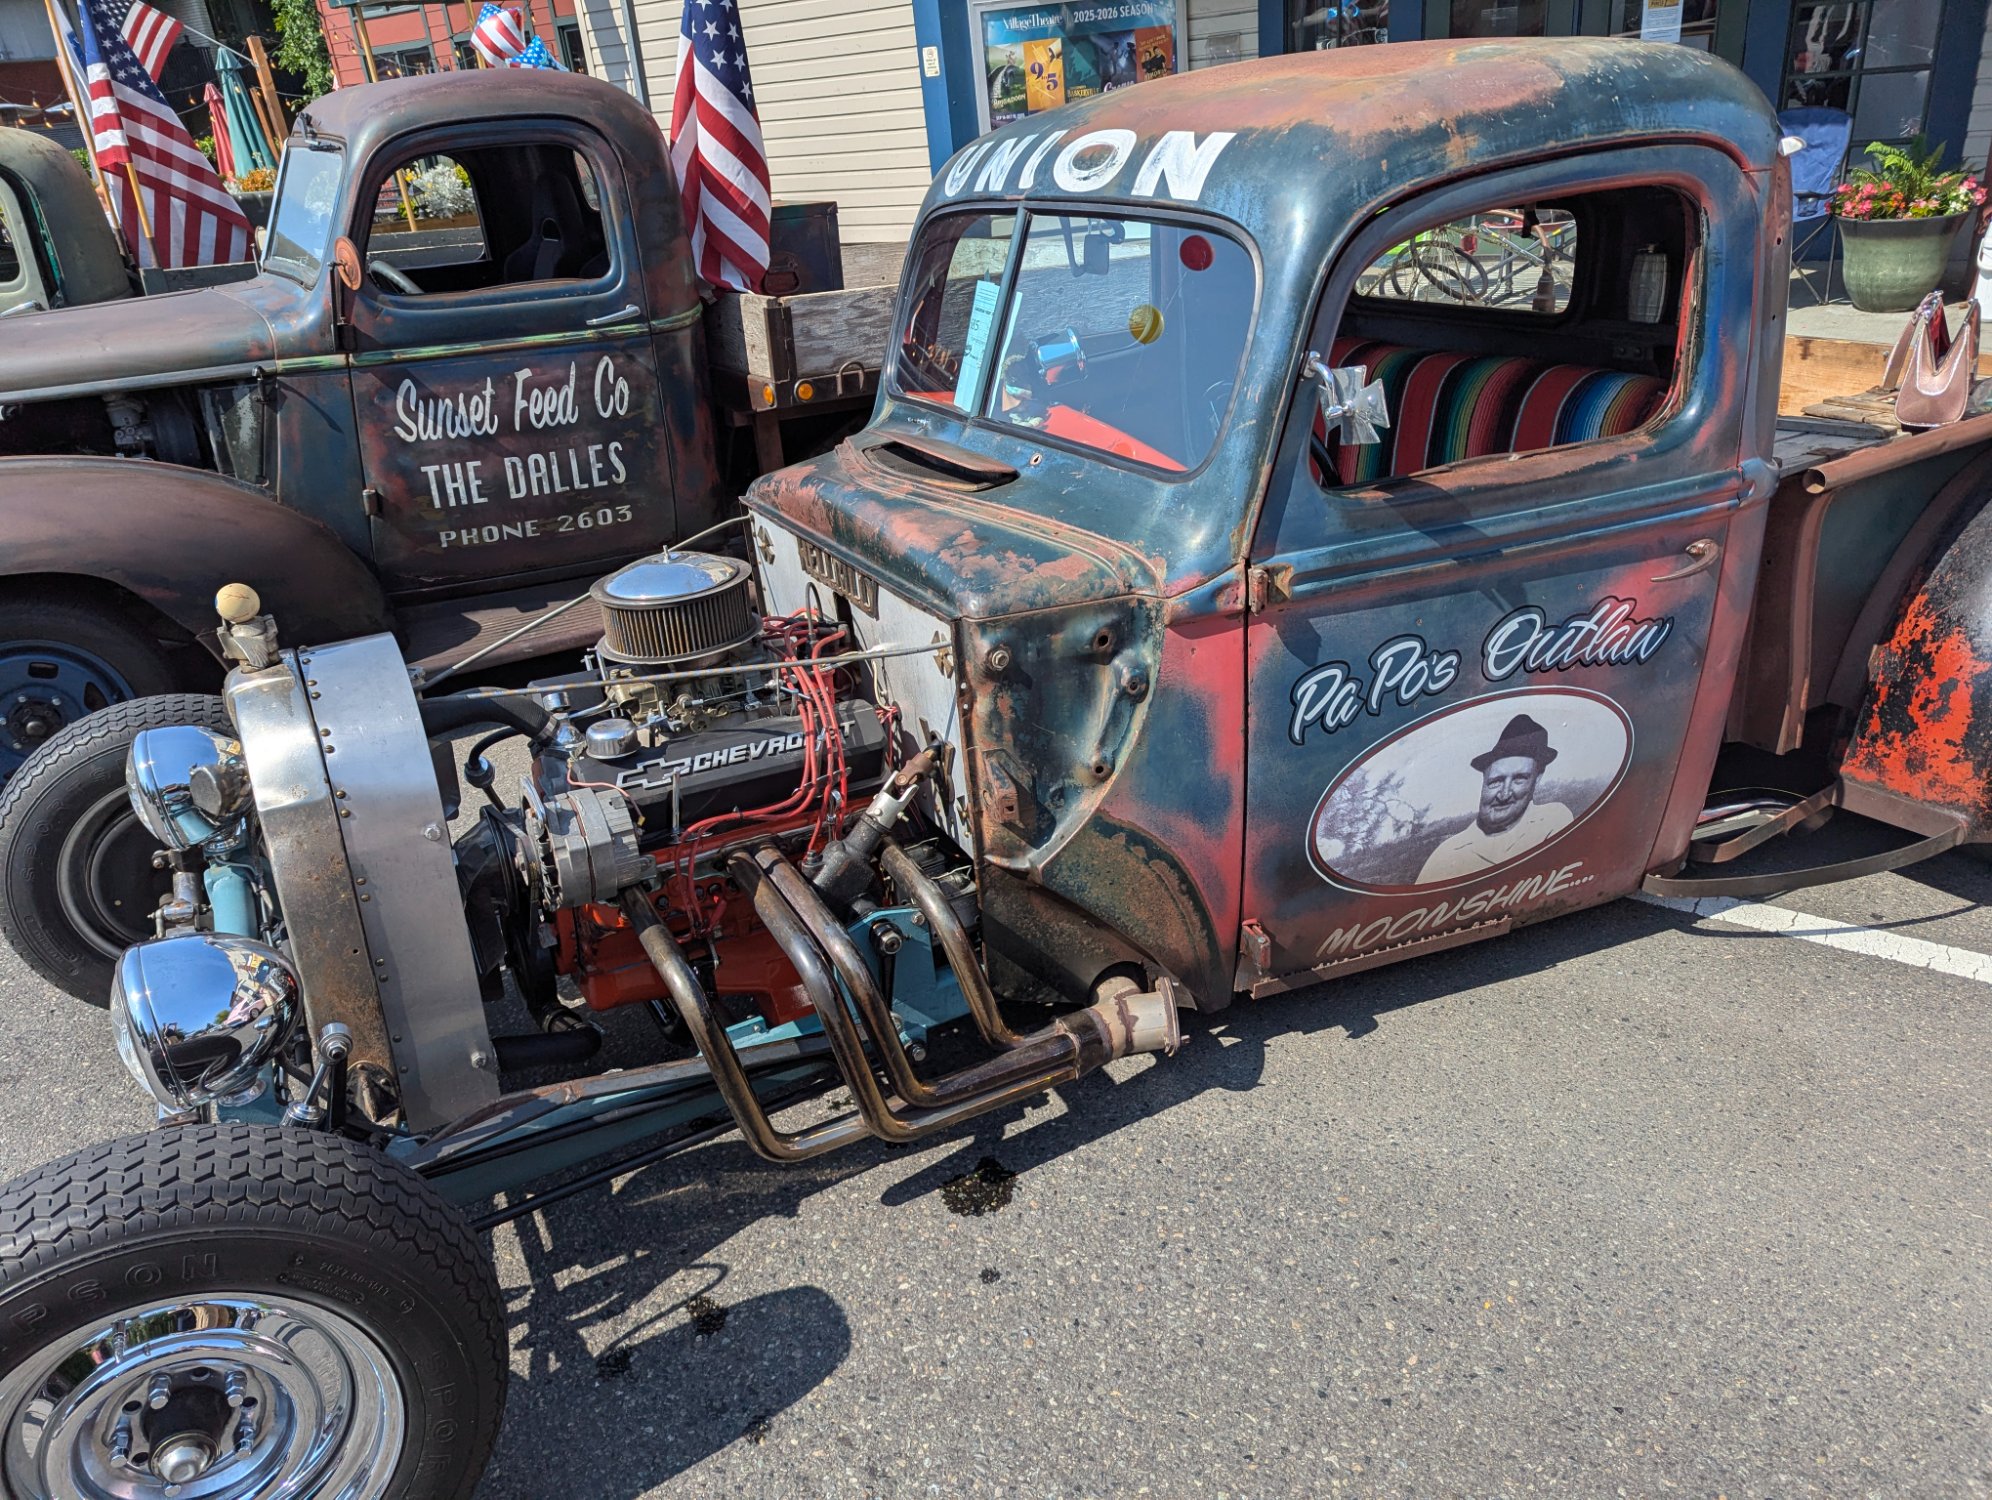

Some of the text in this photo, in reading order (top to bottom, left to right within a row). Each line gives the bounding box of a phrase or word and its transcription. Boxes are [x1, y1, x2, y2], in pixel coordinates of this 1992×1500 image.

[1074, 3, 1153, 23] 2025-2026 SEASON
[1030, 62, 1043, 80] 9
[1046, 73, 1058, 91] 5
[944, 128, 1237, 201] UNION
[393, 355, 629, 442] Sunset Feed Co
[420, 441, 626, 509] THE DALLES
[439, 504, 633, 548] PHONE 2603
[1483, 597, 1673, 680] Outlaw
[692, 720, 856, 773] CHEVROT
